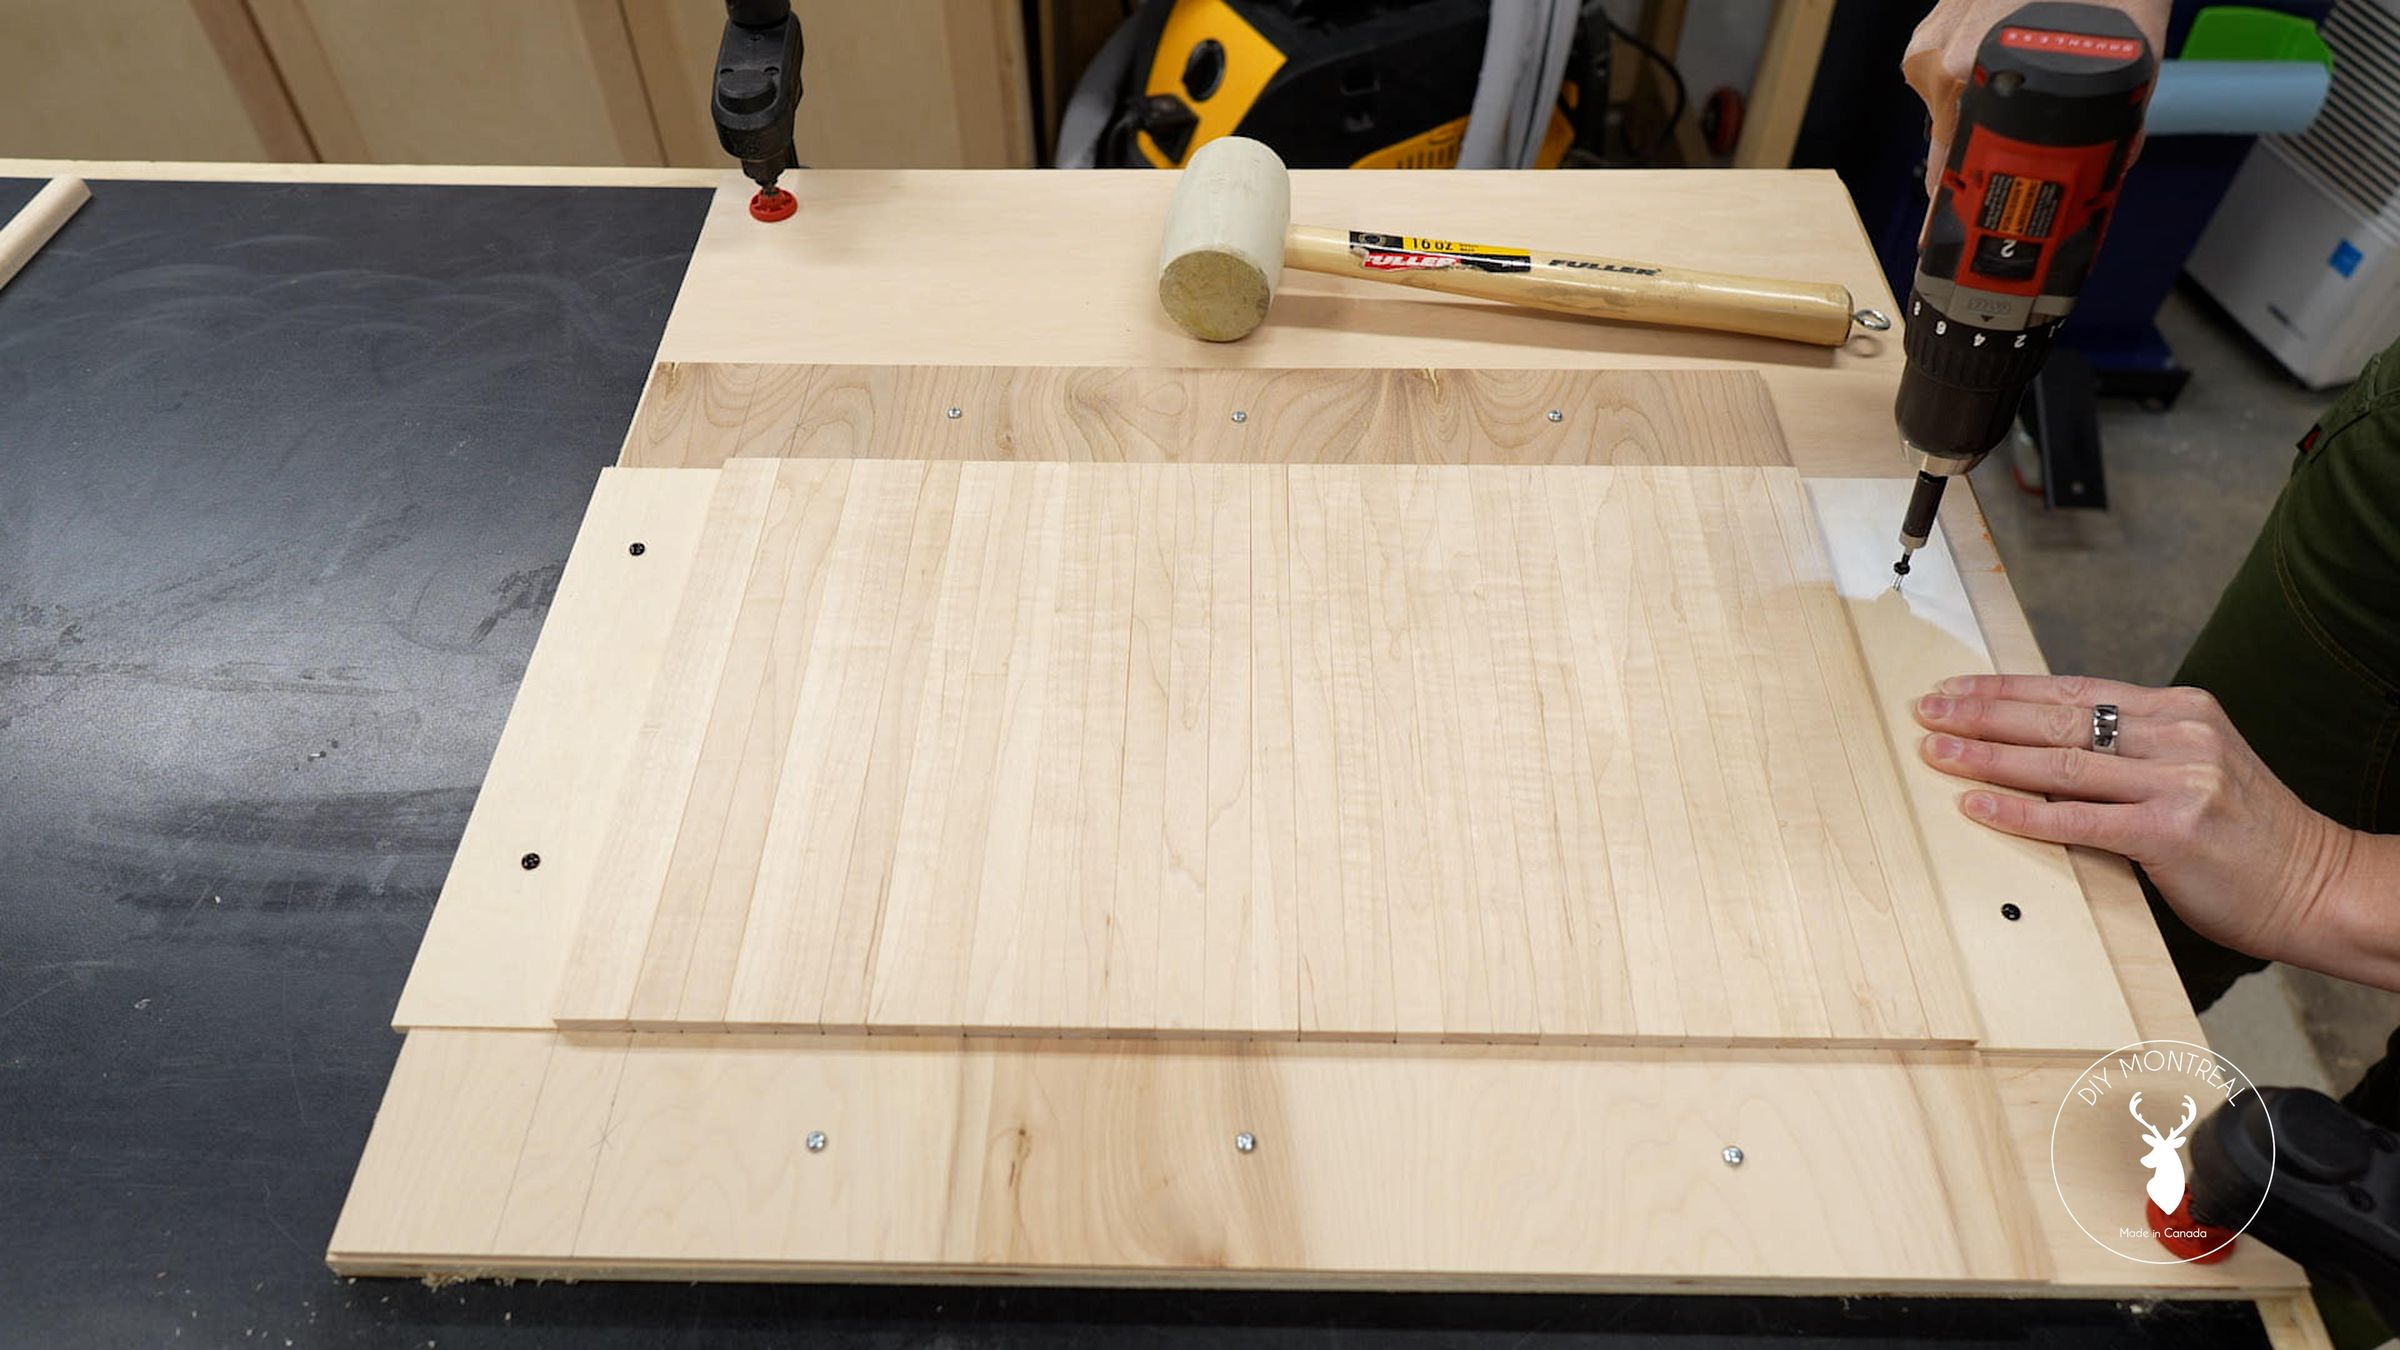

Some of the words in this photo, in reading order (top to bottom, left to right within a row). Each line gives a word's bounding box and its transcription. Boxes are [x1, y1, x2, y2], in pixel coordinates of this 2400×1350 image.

[1412, 237, 1431, 250] 16
[2000, 239, 2017, 258] 2
[1548, 259, 1662, 277] FULLER
[1973, 333, 1986, 347] 4
[2013, 334, 2027, 348] 2
